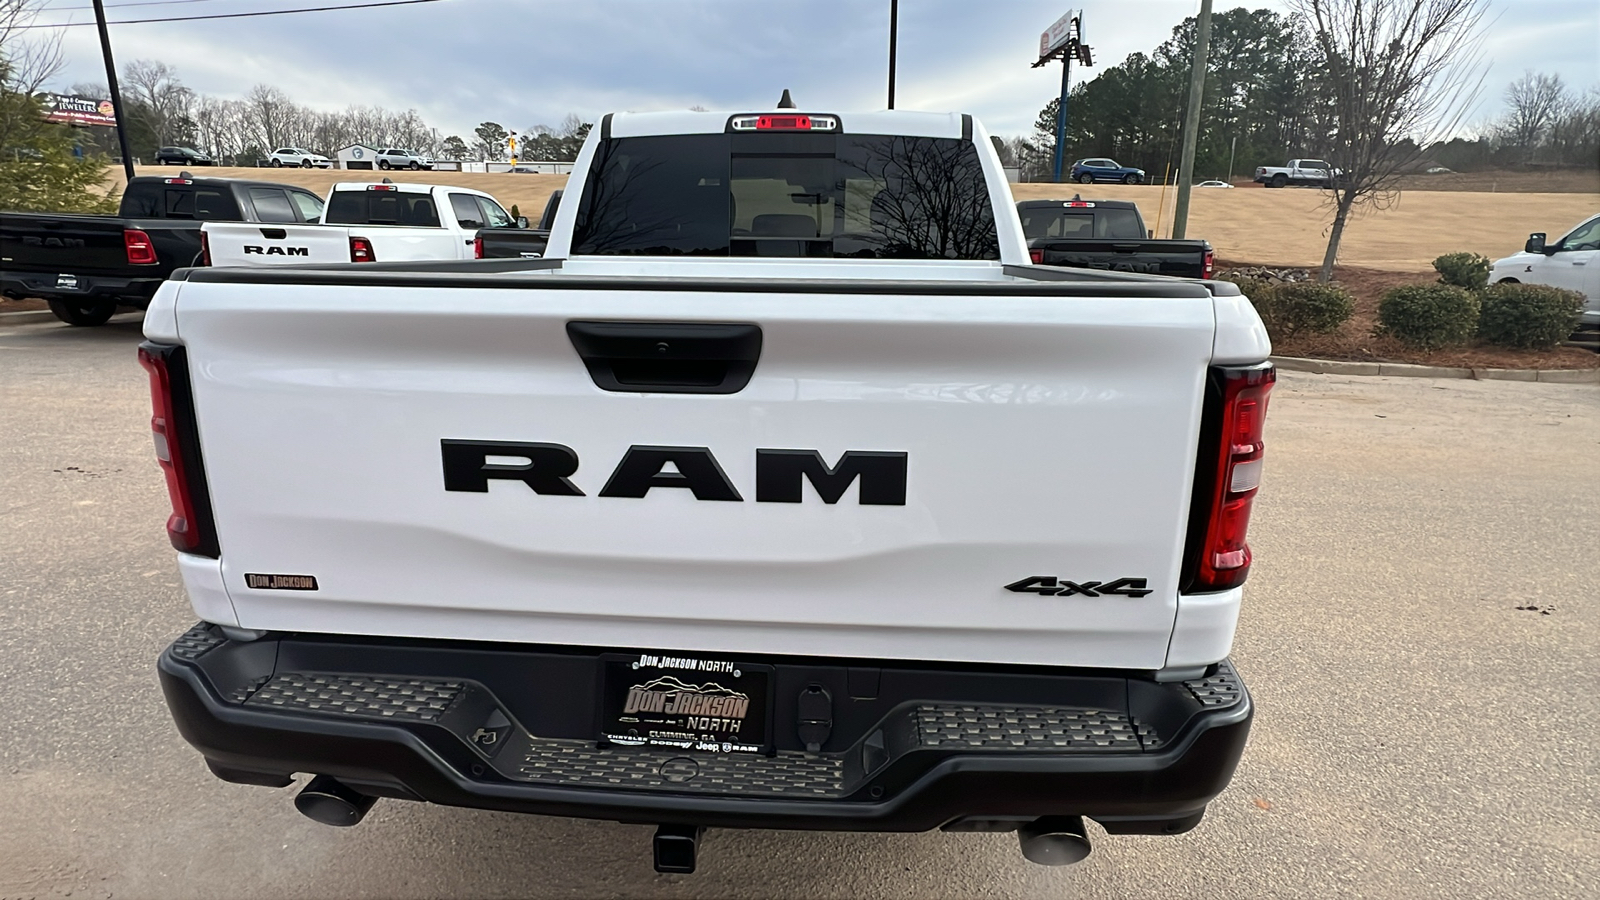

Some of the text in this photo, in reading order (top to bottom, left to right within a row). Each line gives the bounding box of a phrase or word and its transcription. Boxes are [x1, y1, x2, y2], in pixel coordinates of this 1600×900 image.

[59, 103, 97, 112] JEWELERS
[22, 235, 86, 248] RAM
[243, 245, 309, 257] RAM
[440, 438, 908, 505] RAM
[1004, 576, 1154, 598] 4x4
[698, 660, 734, 673] NORTH
[686, 716, 742, 733] NORTH
[607, 734, 648, 742] CHRYSLER
[695, 741, 720, 753] Jeep
[701, 734, 716, 742] GA
